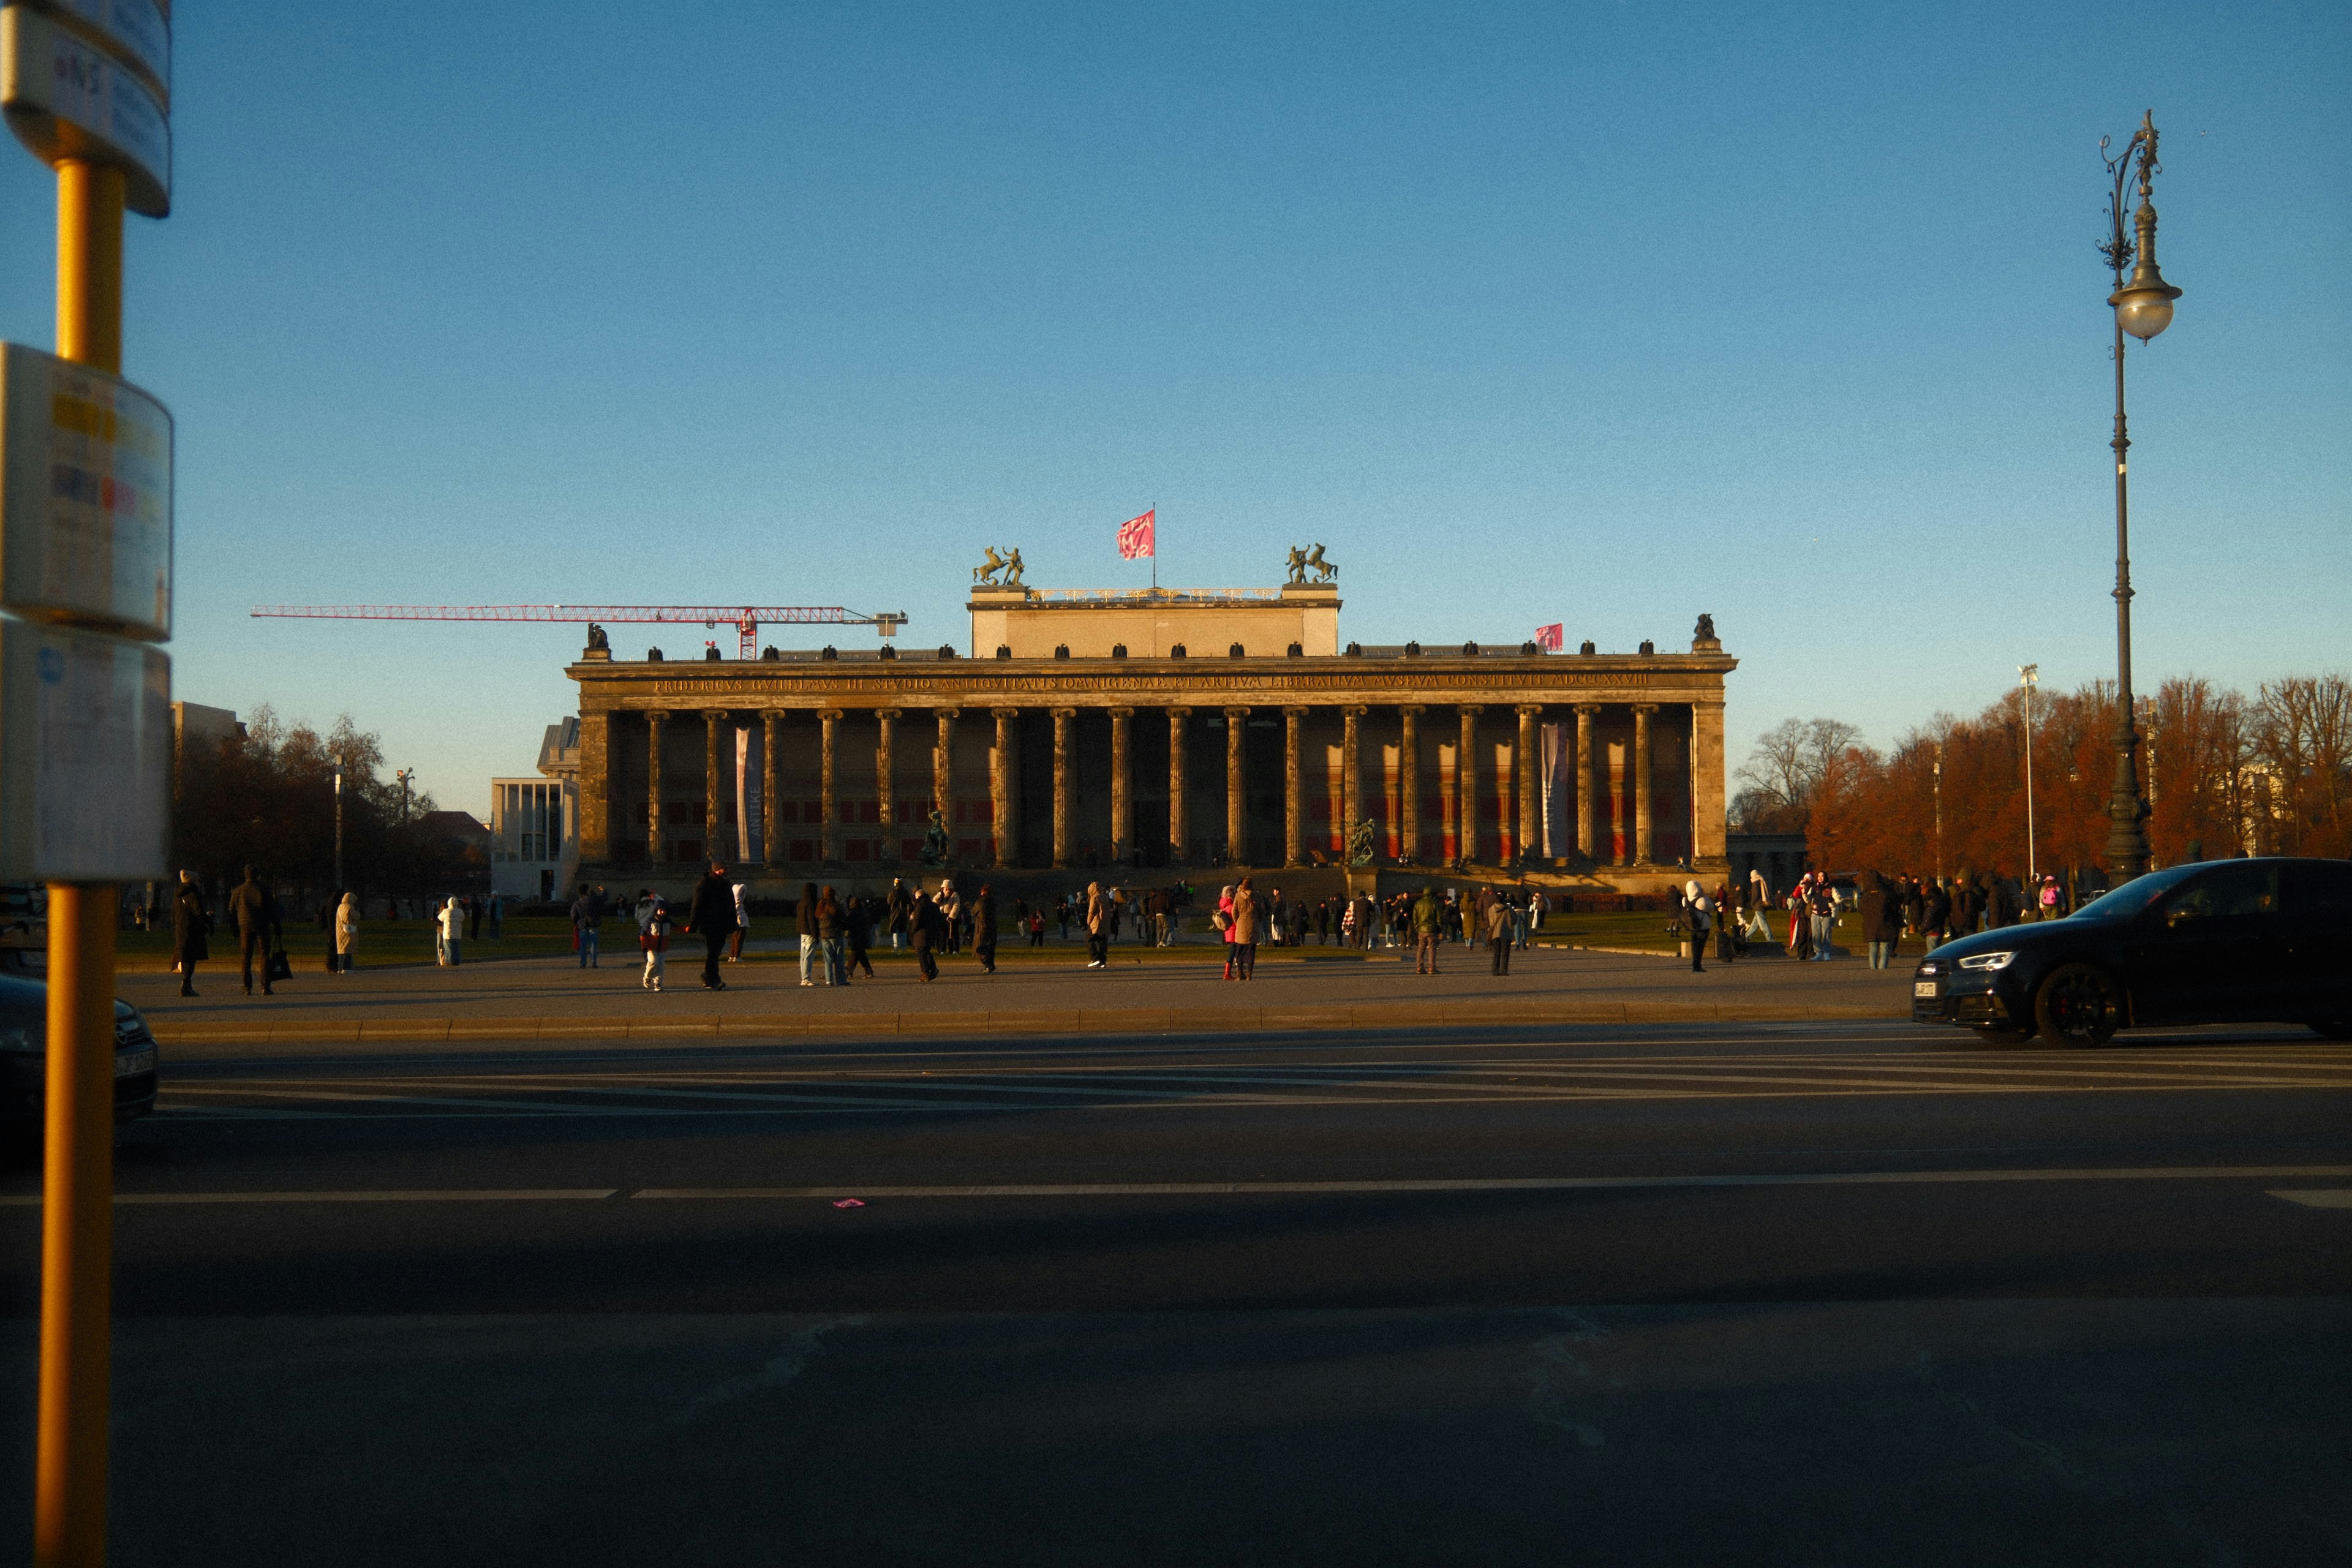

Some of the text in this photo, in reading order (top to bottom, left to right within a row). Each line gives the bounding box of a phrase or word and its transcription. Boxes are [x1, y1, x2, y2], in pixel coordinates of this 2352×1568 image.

[655, 673, 1649, 692] FRIDERICVS GVILELMVS III STVDIO ANTIQVITATIS OMNIGENAE ET ARTIVM LIBERALIVM MVSEVM CONSTITVIT MDCCCXXVIII
[749, 785, 762, 837] ANTIKE
